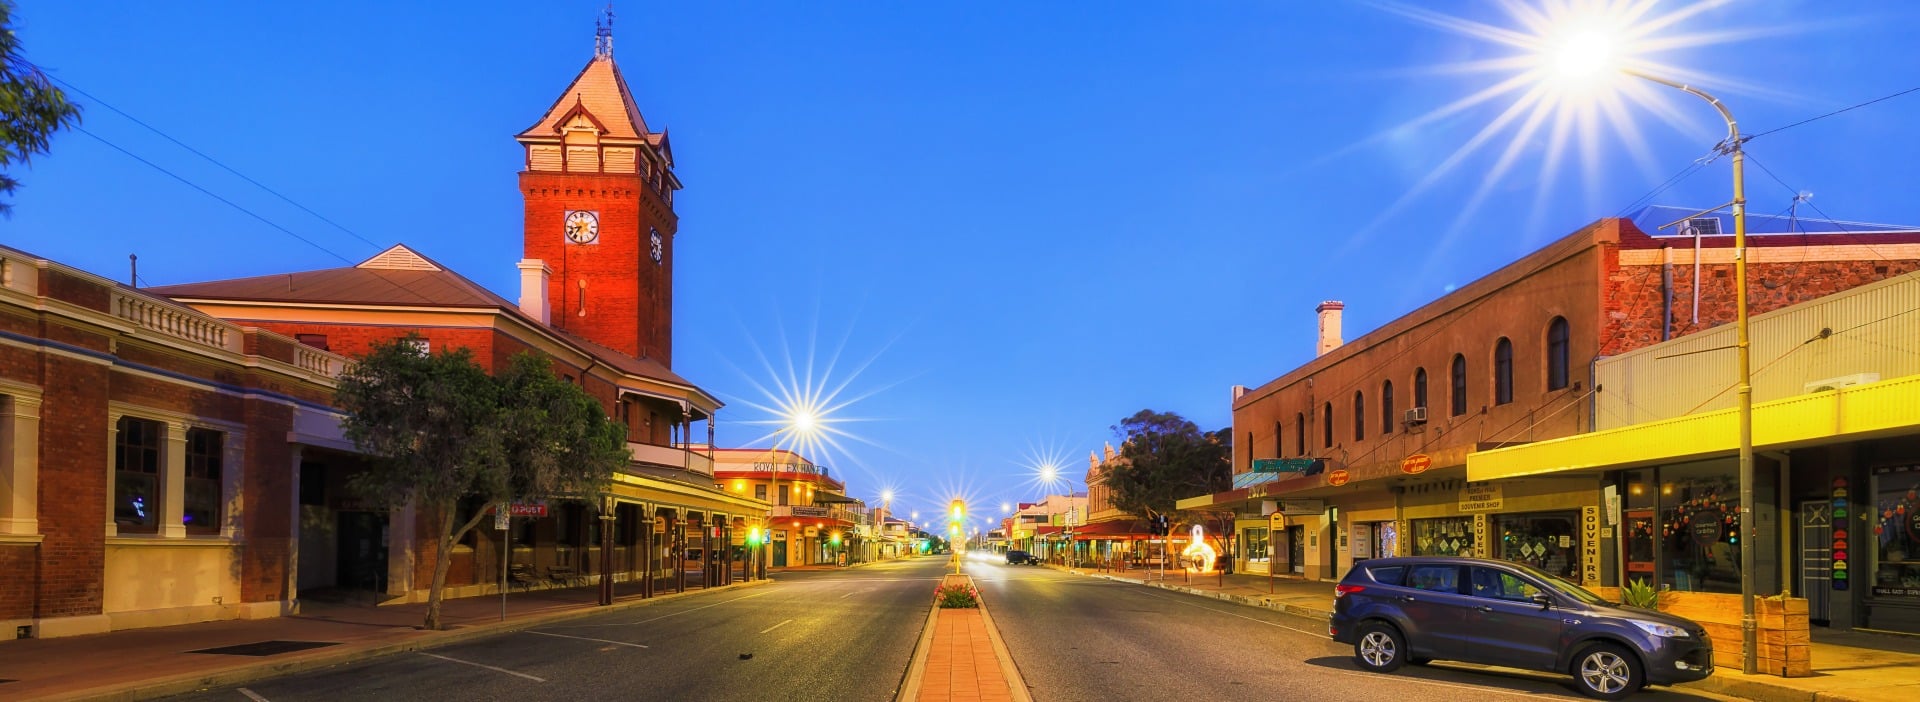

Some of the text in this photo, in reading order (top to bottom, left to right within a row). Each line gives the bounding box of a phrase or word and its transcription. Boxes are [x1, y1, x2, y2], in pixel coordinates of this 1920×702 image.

[1461, 501, 1500, 510] SOUVENIR SHOP
[1476, 515, 1484, 558] SOUVEN
[1586, 507, 1596, 580] SOUVENIRS
